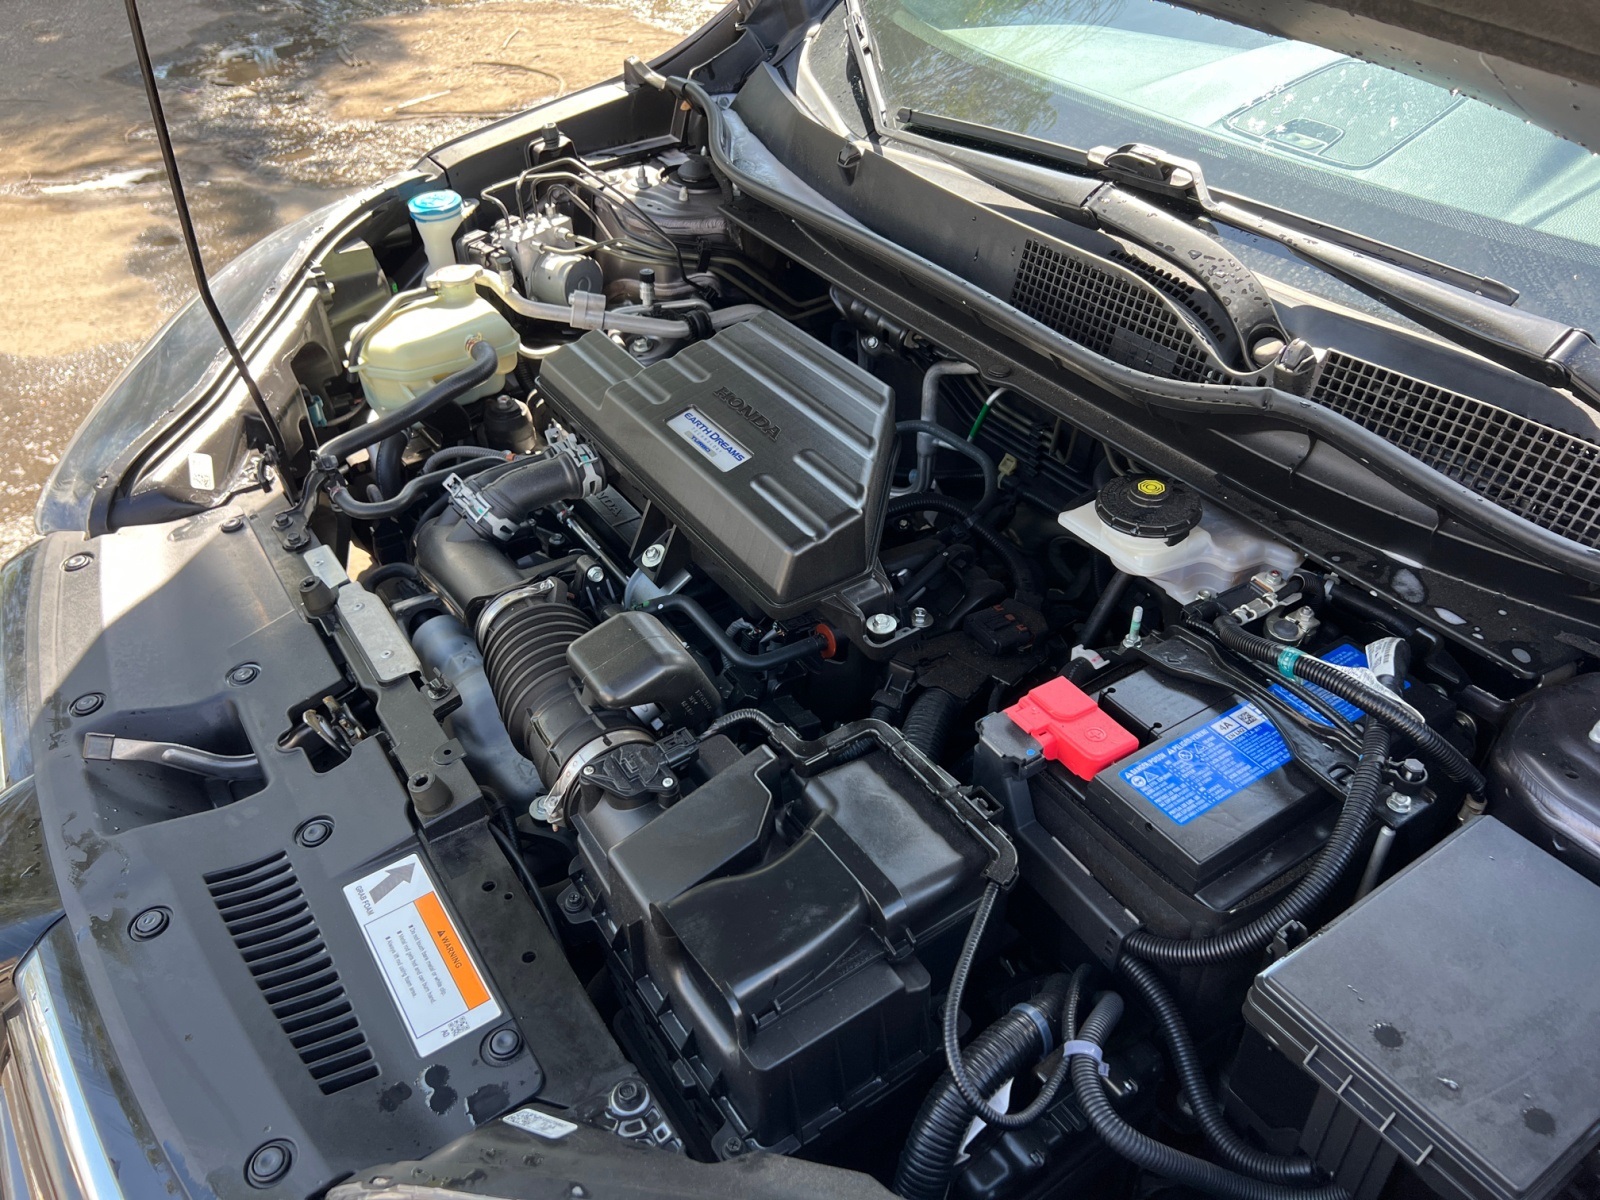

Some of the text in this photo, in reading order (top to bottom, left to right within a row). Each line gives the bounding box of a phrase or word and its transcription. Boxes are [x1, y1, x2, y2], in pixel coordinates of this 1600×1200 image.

[713, 386, 781, 442] HONDA
[684, 412, 745, 462] EARTH DREAMS
[691, 435, 711, 453] TURBO
[1219, 720, 1233, 731] 4A
[355, 885, 374, 916] GRAB FOAM
[412, 933, 420, 941] not
[387, 939, 397, 955] Always
[415, 939, 425, 952] touch
[442, 936, 463, 969] WARNING
[395, 957, 403, 966] rod
[403, 943, 411, 952] rod
[410, 959, 418, 967] hot
[414, 966, 422, 975] and
[425, 959, 435, 972] metal
[398, 964, 408, 978] using
[433, 975, 443, 988] white
